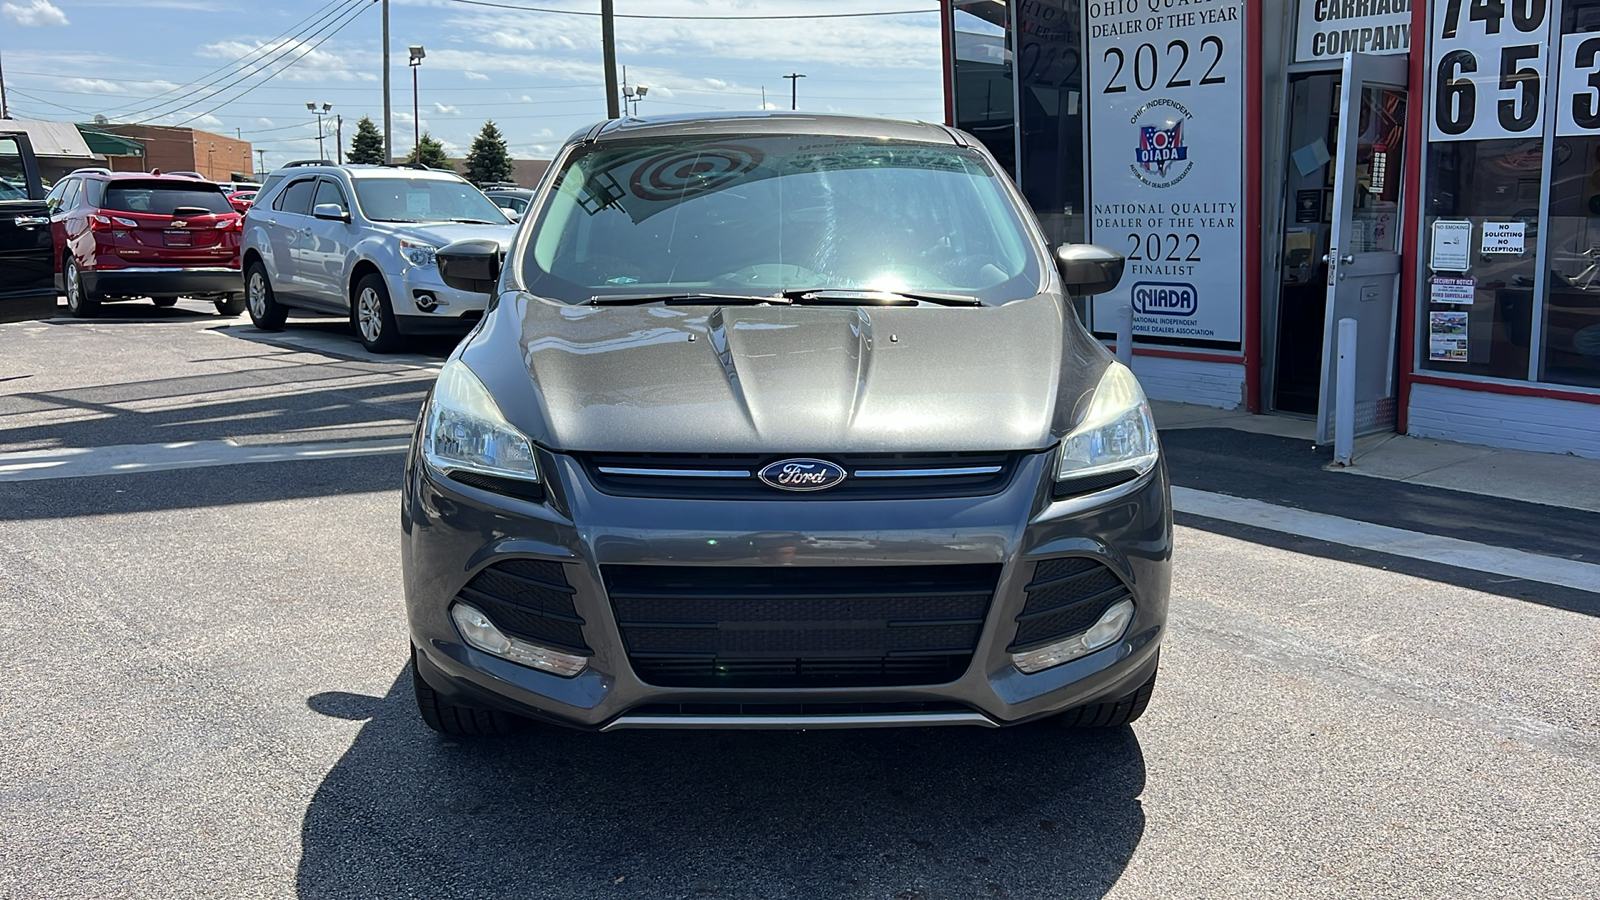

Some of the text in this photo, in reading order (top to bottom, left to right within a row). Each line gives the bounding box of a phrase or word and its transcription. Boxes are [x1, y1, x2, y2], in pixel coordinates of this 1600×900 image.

[1090, 0, 1138, 18] OHIO
[1092, 19, 1143, 38] DEALER
[1146, 17, 1163, 31] OF
[1167, 12, 1195, 29] THE
[1199, 6, 1238, 25] YEAR
[1312, 23, 1411, 56] COMPANY
[1103, 35, 1226, 94] 2022
[1146, 98, 1193, 120] INDEPENDENT
[1141, 149, 1179, 161] OIADA
[1170, 160, 1194, 186] ASSOCIATION
[1094, 203, 1237, 215] NATIONAL QUALITY
[1096, 218, 1235, 228] DEALER OF THE YEAR
[1127, 233, 1201, 262] 2022
[1132, 265, 1194, 275] FINALIST
[1136, 288, 1191, 309] NIADA
[1133, 316, 1197, 326] NATIONAL INDEPENDENT
[1176, 328, 1214, 336] ASSOCIATION
[778, 463, 827, 484] Ford
